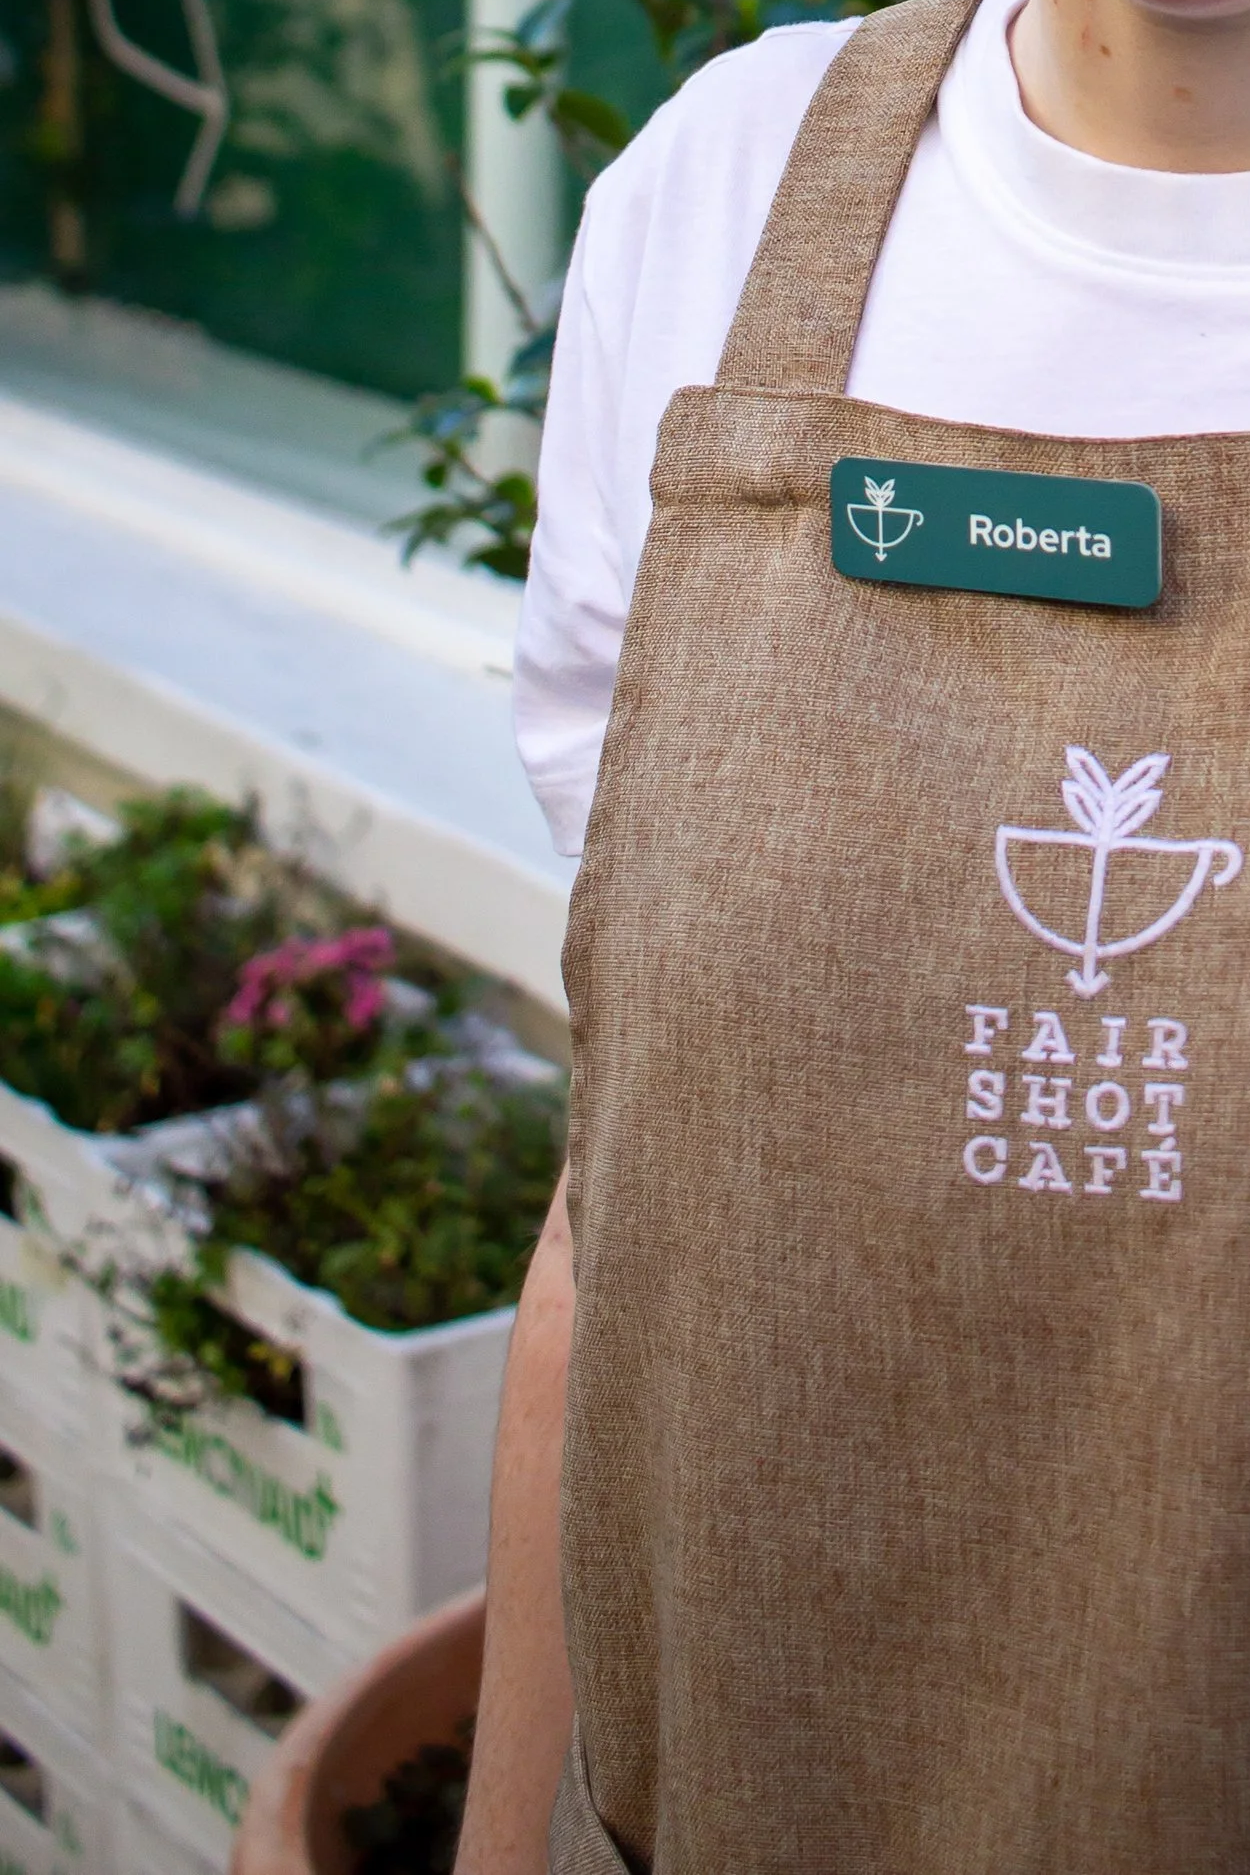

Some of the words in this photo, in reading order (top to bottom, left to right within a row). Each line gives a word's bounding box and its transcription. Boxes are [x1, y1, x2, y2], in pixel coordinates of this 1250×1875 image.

[969, 513, 1112, 559] Roberta
[963, 1003, 1190, 1071] FAIR
[965, 1068, 1186, 1137] SHOT
[961, 1135, 1184, 1203] CAFÉ
